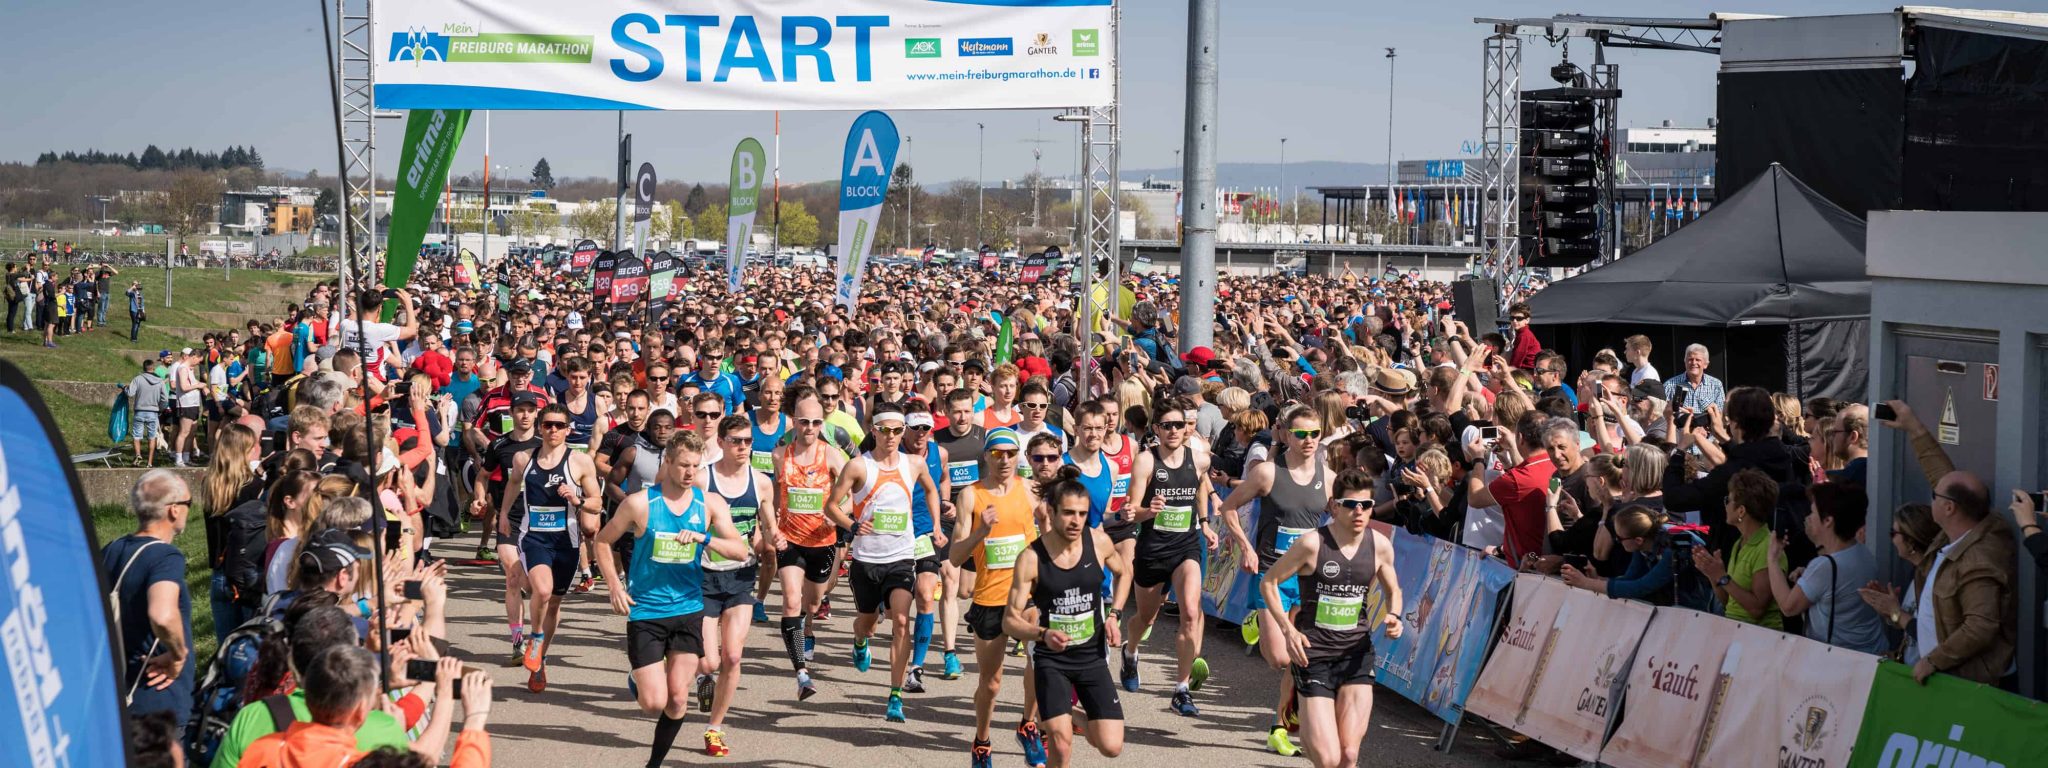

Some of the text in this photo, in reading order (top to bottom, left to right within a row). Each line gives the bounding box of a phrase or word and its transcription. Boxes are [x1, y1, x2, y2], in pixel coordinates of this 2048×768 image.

[443, 22, 473, 34] Mein
[451, 41, 589, 56] FREIBURG MARATHON
[609, 12, 890, 84] START
[910, 41, 936, 50] AOK
[961, 40, 1009, 54] Heitzmann
[1027, 46, 1058, 56] GANTER
[906, 67, 1077, 81] www.mein-freiburgmarathon.de
[407, 109, 447, 189] erima
[850, 128, 885, 177] A
[739, 151, 756, 190] B
[639, 172, 652, 202] C
[846, 185, 880, 197] BLOCK
[732, 197, 755, 207] BLOCK
[627, 266, 644, 275] cep
[596, 277, 610, 290] 1:29
[613, 283, 639, 297] 1:29
[954, 468, 969, 476] 605
[1155, 488, 1197, 496] DRESCHER
[793, 495, 817, 504] 10471
[540, 514, 556, 522] 378
[881, 515, 903, 524] 3695
[1164, 513, 1185, 521] 3549
[994, 545, 1019, 556] 3379
[1064, 587, 1080, 598] TUS
[1325, 606, 1357, 617] 13405
[1060, 623, 1087, 635] 3854
